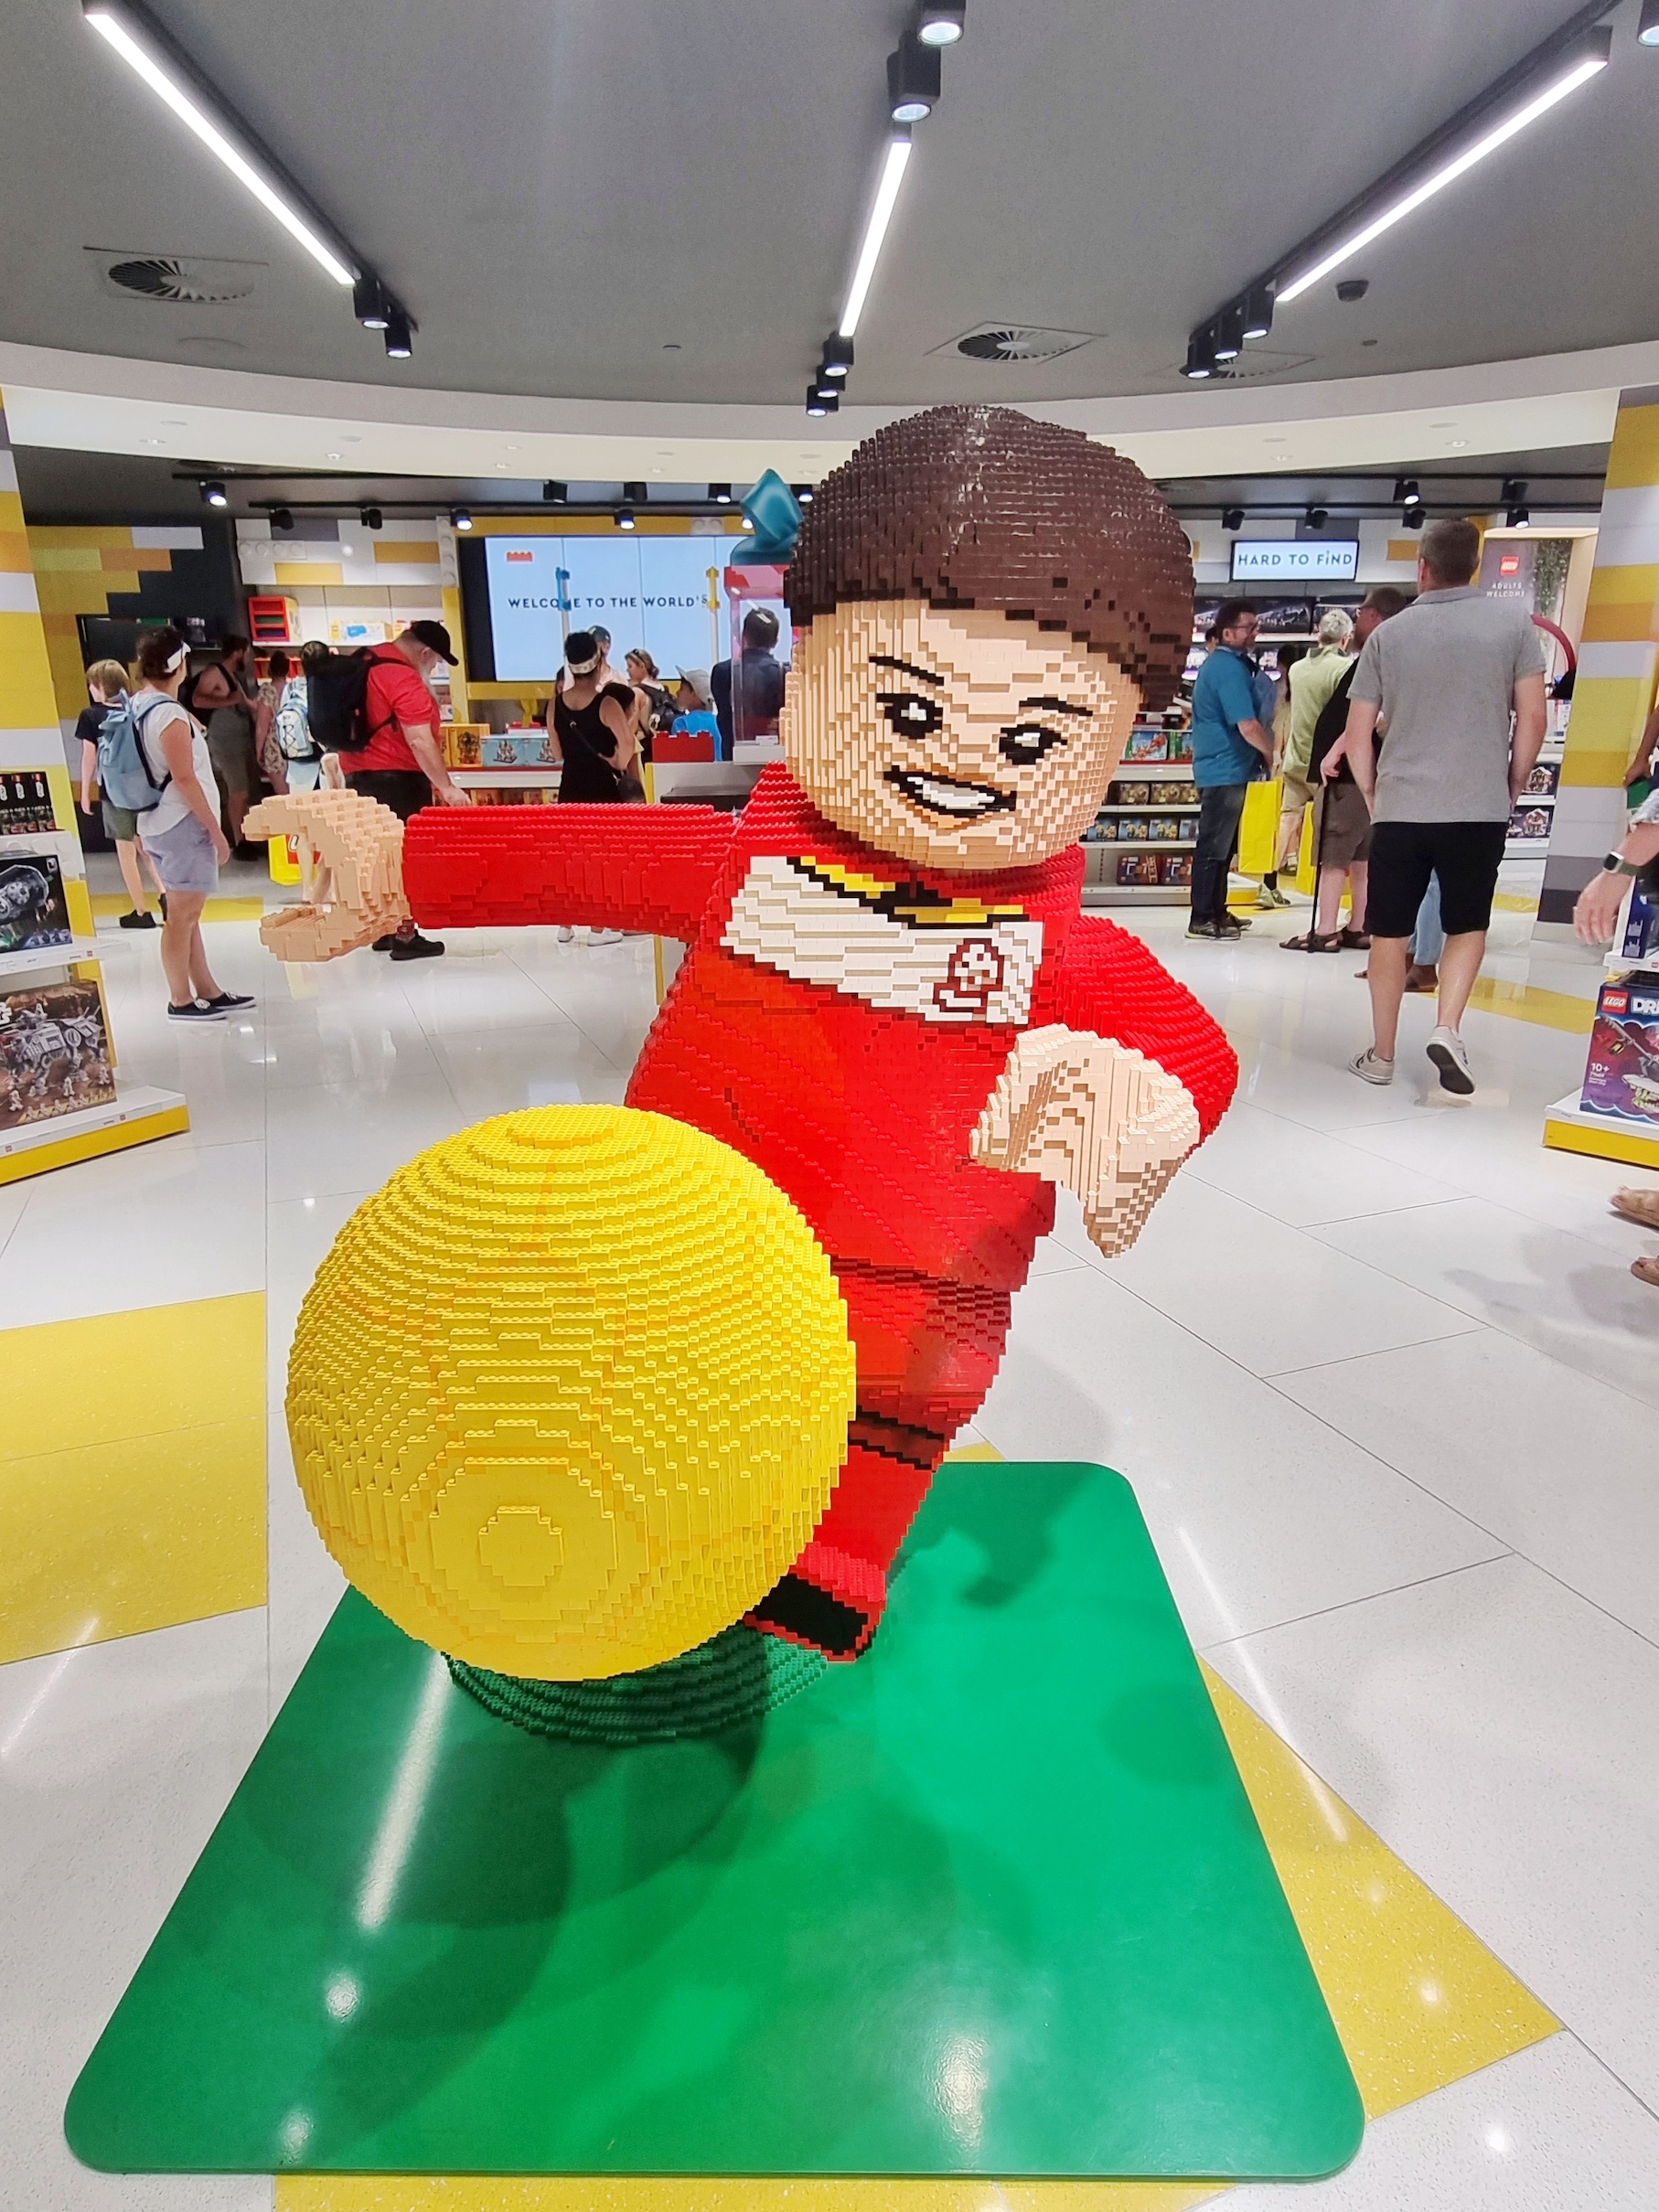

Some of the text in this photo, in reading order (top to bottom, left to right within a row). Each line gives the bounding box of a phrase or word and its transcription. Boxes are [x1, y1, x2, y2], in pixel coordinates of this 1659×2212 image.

[1238, 553, 1281, 566] HARD
[1289, 554, 1310, 565] TO
[508, 597, 581, 609] WELCOE
[586, 597, 605, 608] TO
[610, 597, 637, 607] THE
[1603, 996, 1659, 1015] LEGO DR
[1590, 1063, 1610, 1073] 10+
